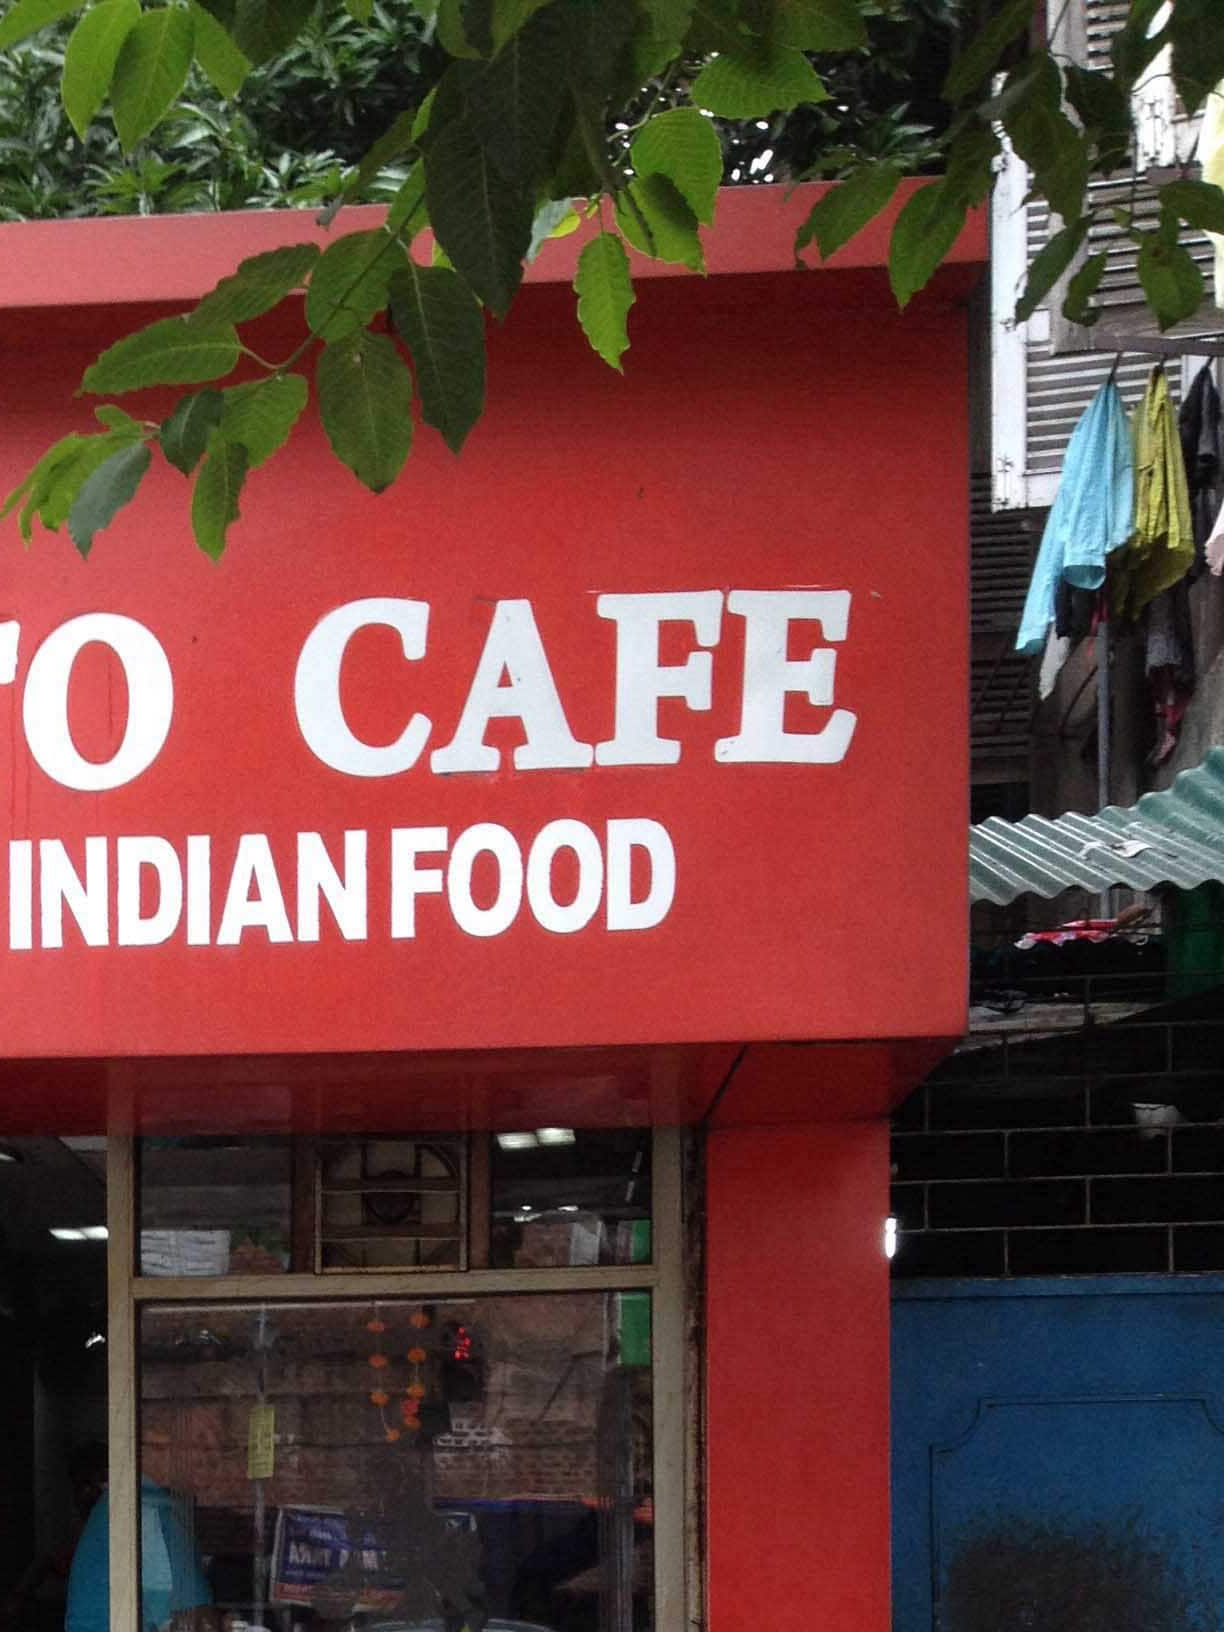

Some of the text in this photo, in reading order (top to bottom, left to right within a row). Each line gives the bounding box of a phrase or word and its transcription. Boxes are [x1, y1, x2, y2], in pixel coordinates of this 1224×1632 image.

[294, 589, 859, 778] CAFE
[9, 829, 368, 953] INDIAN
[390, 817, 677, 940] FOOD
